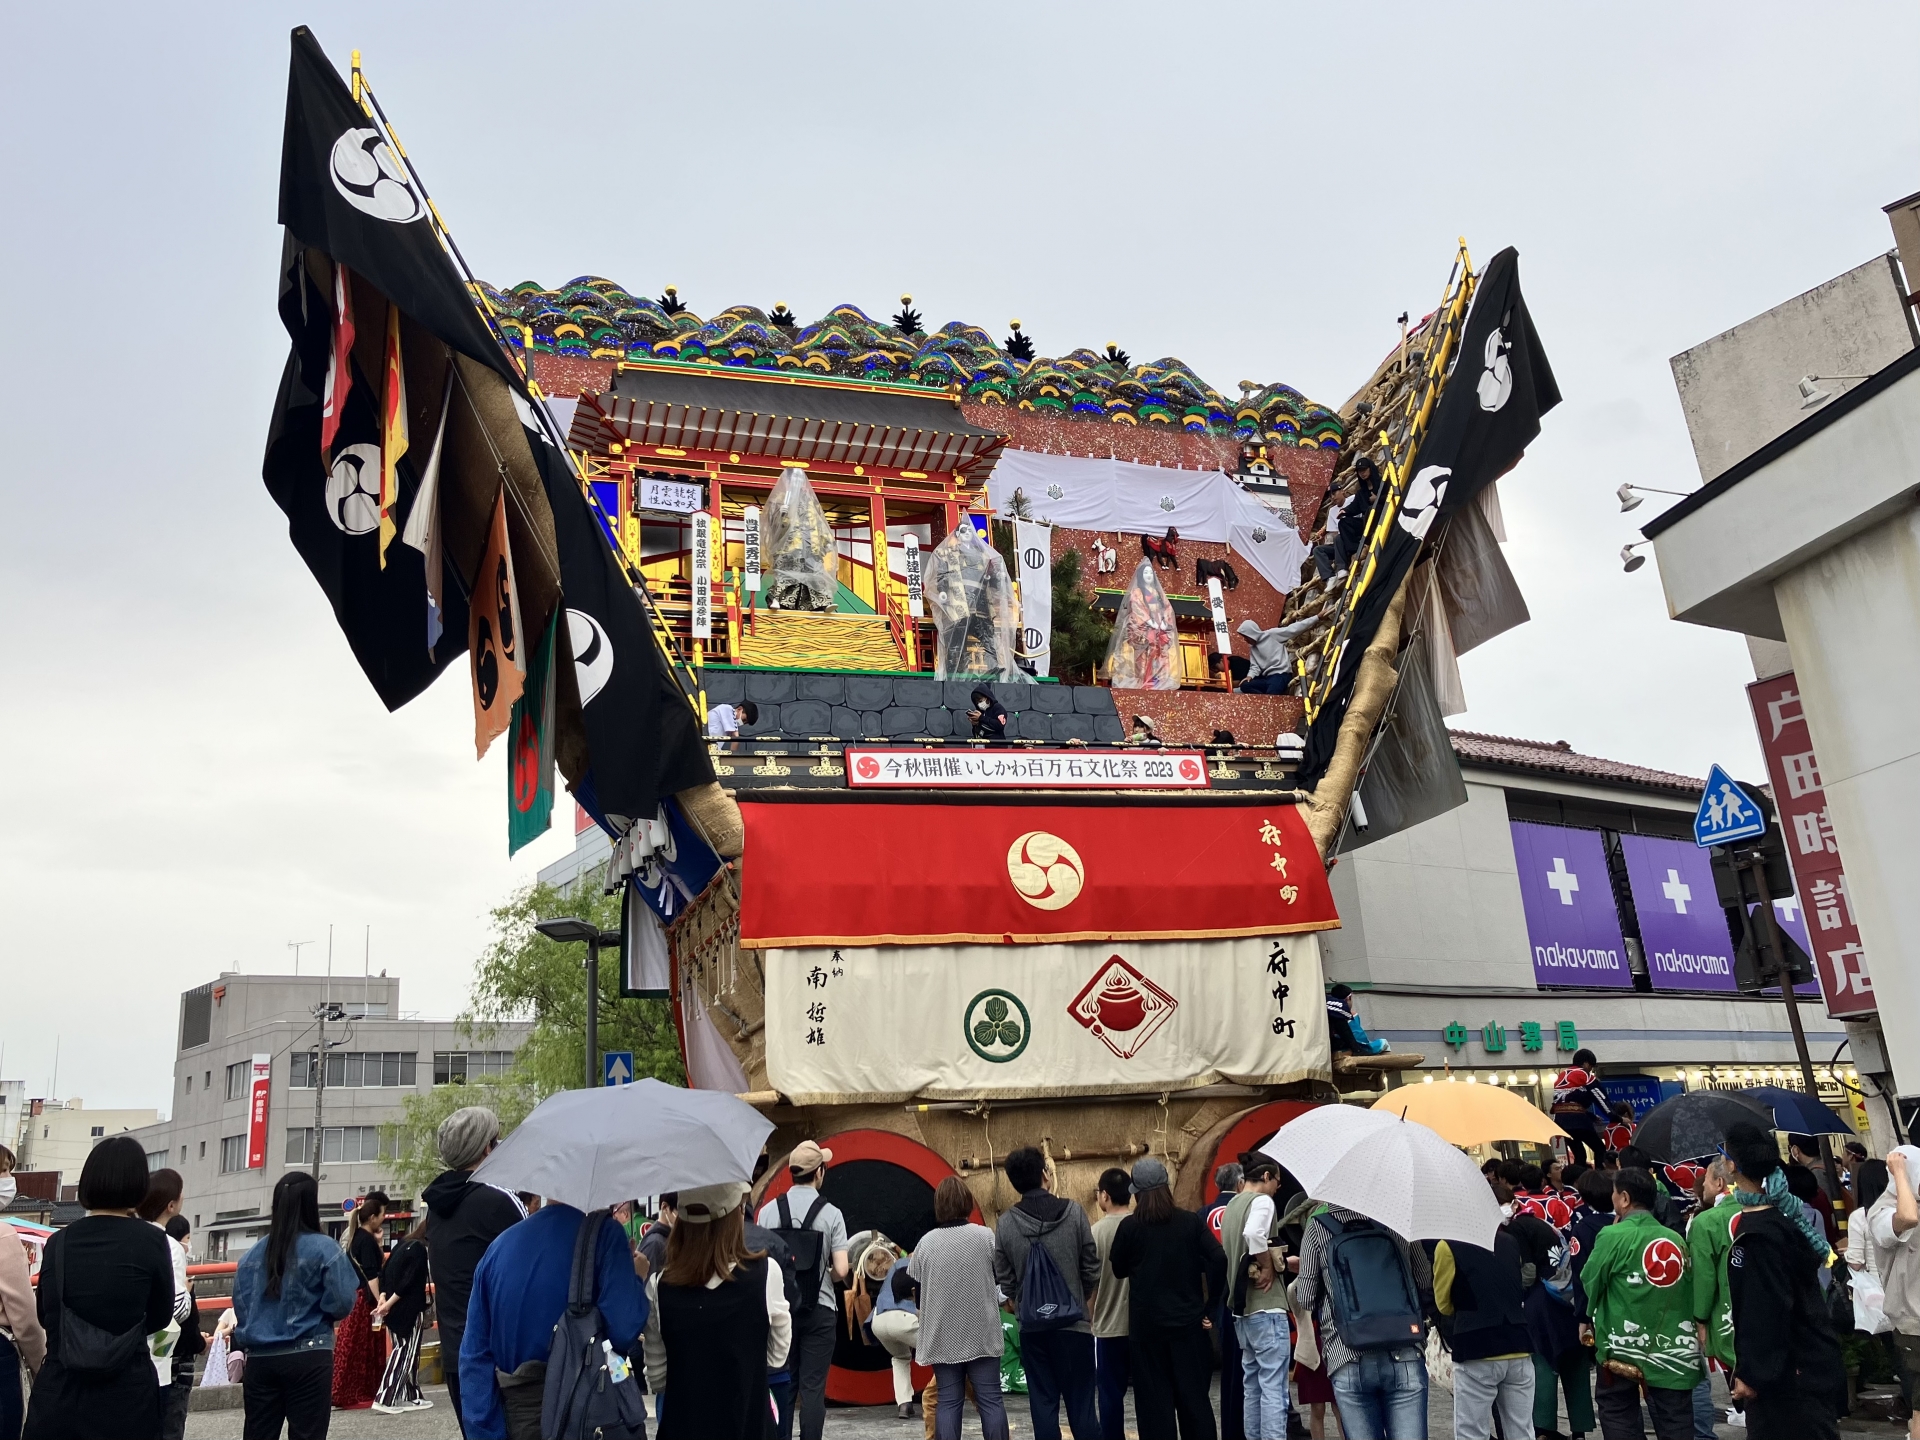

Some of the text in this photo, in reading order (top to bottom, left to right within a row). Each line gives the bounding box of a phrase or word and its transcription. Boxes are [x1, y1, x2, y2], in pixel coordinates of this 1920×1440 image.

[695, 518, 707, 569] 独眼竜政宗
[745, 518, 760, 575] 豊臣秀吉
[906, 546, 922, 601] 伊達政宗
[1211, 596, 1229, 634] 愛姫
[1144, 760, 1174, 778] 2023
[1258, 818, 1299, 905] 府中町
[831, 950, 845, 978] 奉納
[1535, 942, 1620, 970] nakayama
[1655, 948, 1730, 975] nakayama
[1266, 941, 1296, 1039] 府中町
[1443, 1020, 1579, 1052] 中山薬局
